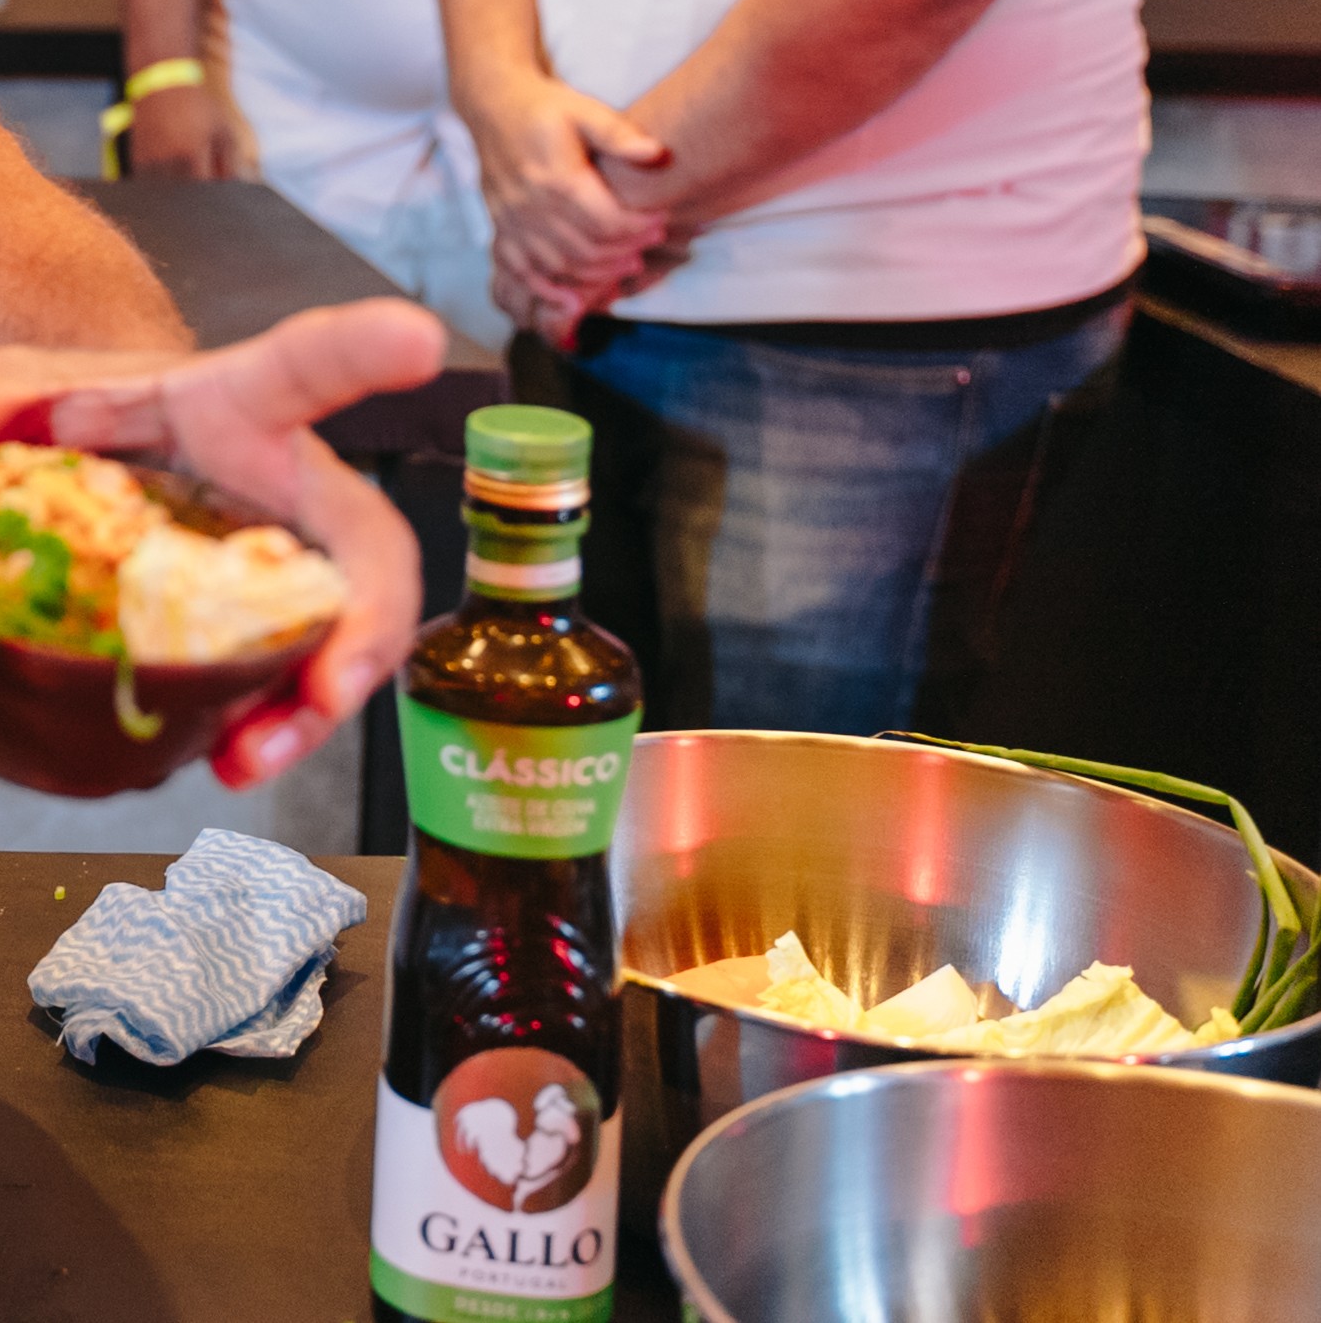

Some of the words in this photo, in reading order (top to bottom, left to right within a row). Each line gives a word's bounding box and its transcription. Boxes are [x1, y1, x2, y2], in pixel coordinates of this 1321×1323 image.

[439, 744, 620, 789] CLÁSSICO
[420, 1211, 603, 1268] GALLO
[459, 1266, 566, 1291] PORTUGAL
